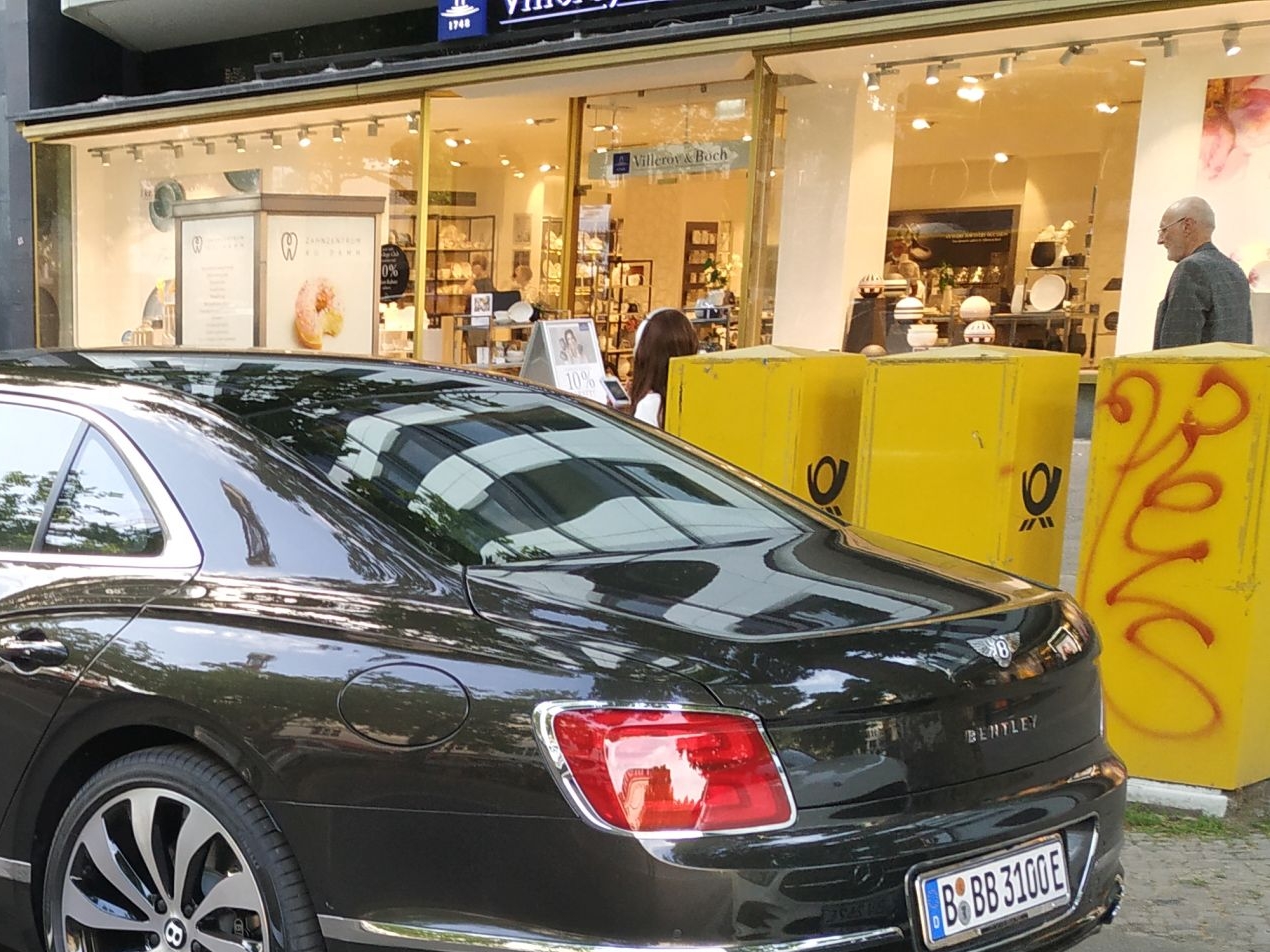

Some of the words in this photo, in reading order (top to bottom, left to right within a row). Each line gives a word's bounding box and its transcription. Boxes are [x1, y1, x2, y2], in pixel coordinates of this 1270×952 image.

[448, 19, 471, 31] 1748
[695, 147, 728, 163] Boch
[567, 370, 596, 391] 10%
[965, 714, 1038, 743] BENTLEY
[942, 884, 958, 928] B
[970, 871, 999, 918] BB
